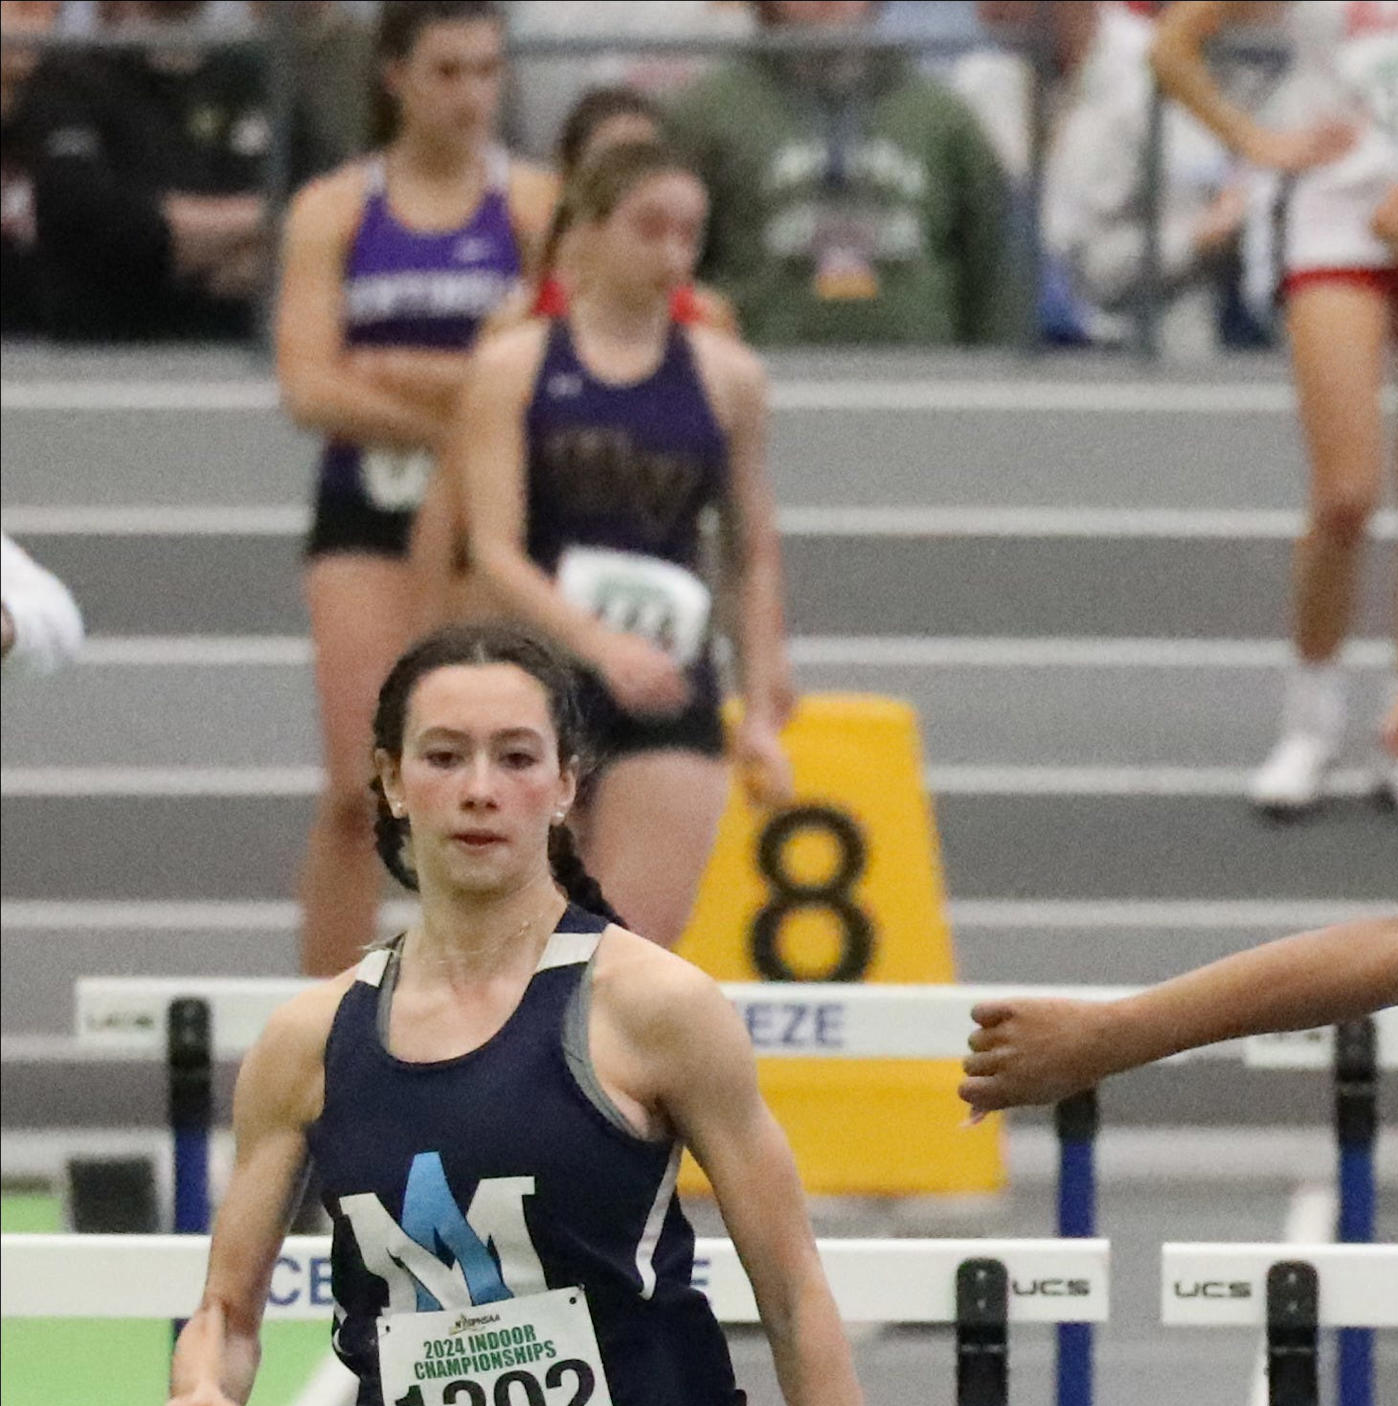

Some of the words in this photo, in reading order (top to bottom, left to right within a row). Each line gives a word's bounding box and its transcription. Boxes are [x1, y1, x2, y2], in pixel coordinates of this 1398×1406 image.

[752, 804, 874, 984] 8
[744, 1003, 844, 1047] EZE
[1012, 1277, 1091, 1297] UCS
[1173, 1281, 1252, 1299] UCS
[414, 1340, 557, 1380] CHAMPIONSHIPS
[423, 1338, 465, 1359] 2024
[468, 1324, 537, 1351] INDOOR
